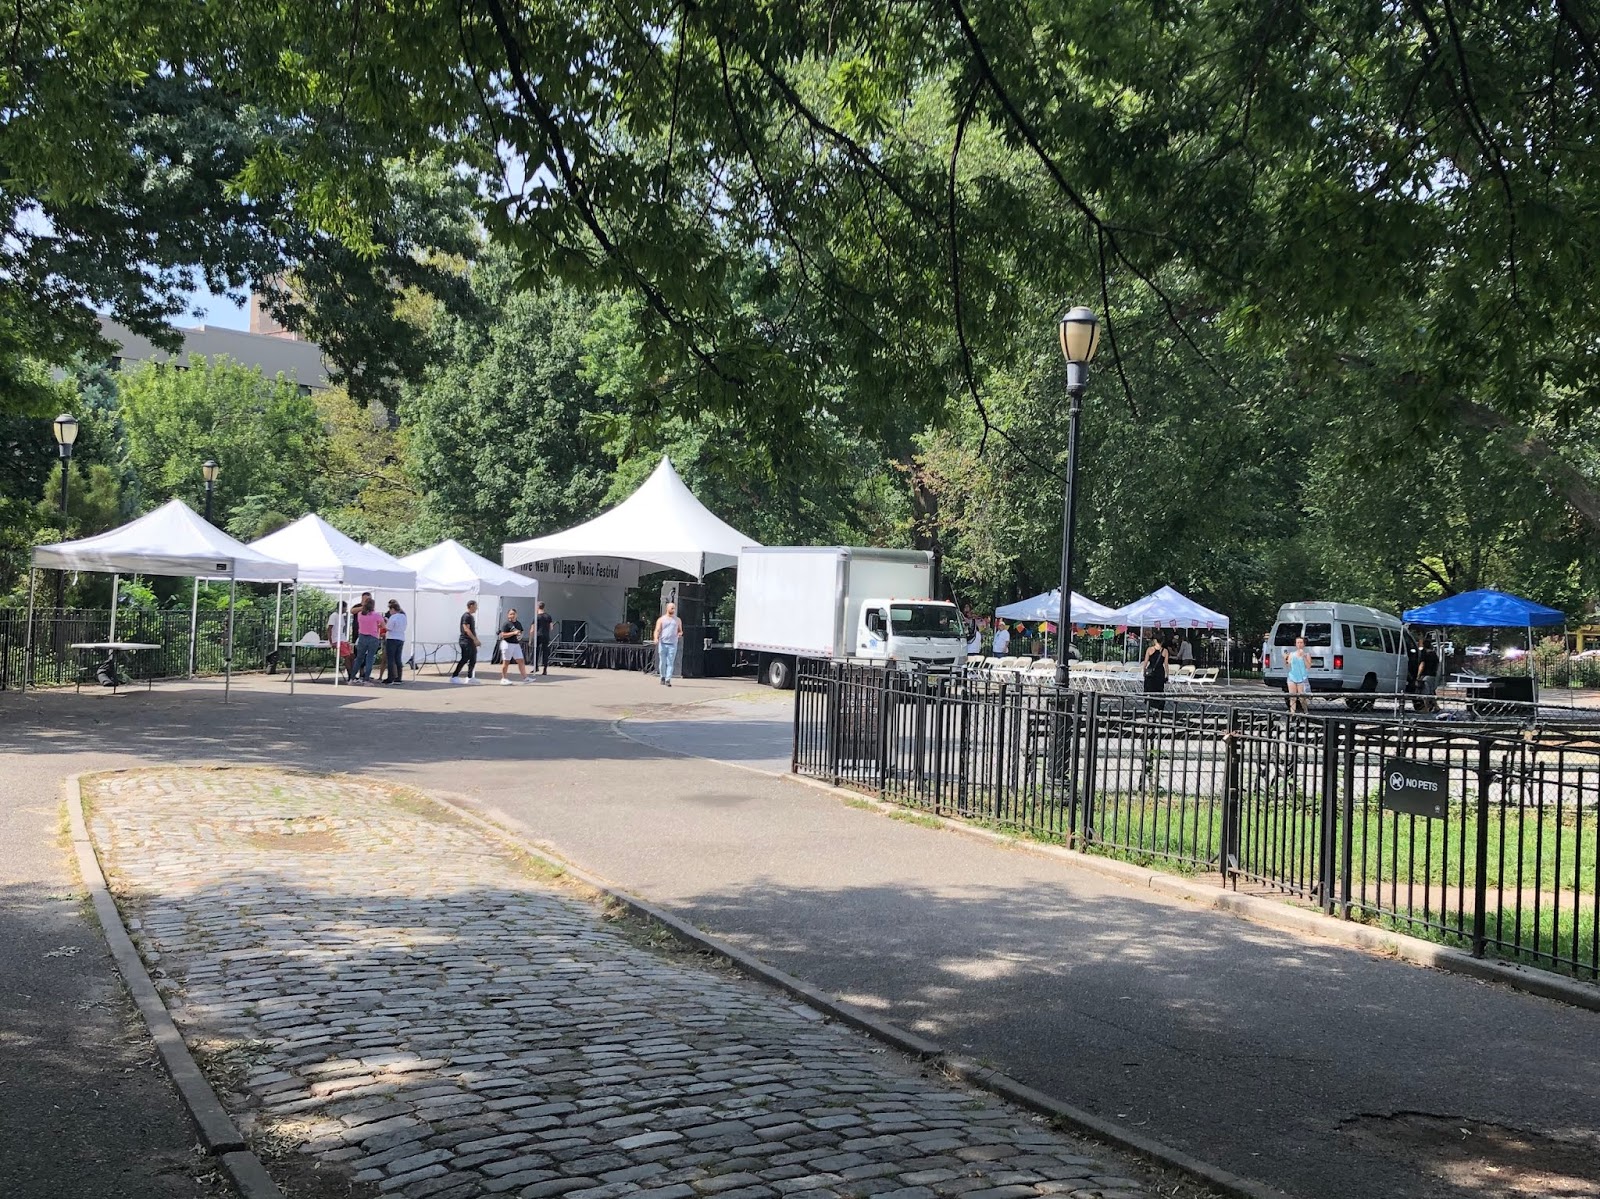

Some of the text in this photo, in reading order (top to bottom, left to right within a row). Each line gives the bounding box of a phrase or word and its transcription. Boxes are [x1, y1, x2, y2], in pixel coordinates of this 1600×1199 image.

[535, 561, 549, 572] New
[553, 558, 575, 578] Village
[578, 561, 594, 576] Music
[596, 563, 619, 578] Festival
[1406, 778, 1438, 791] NO PETS
